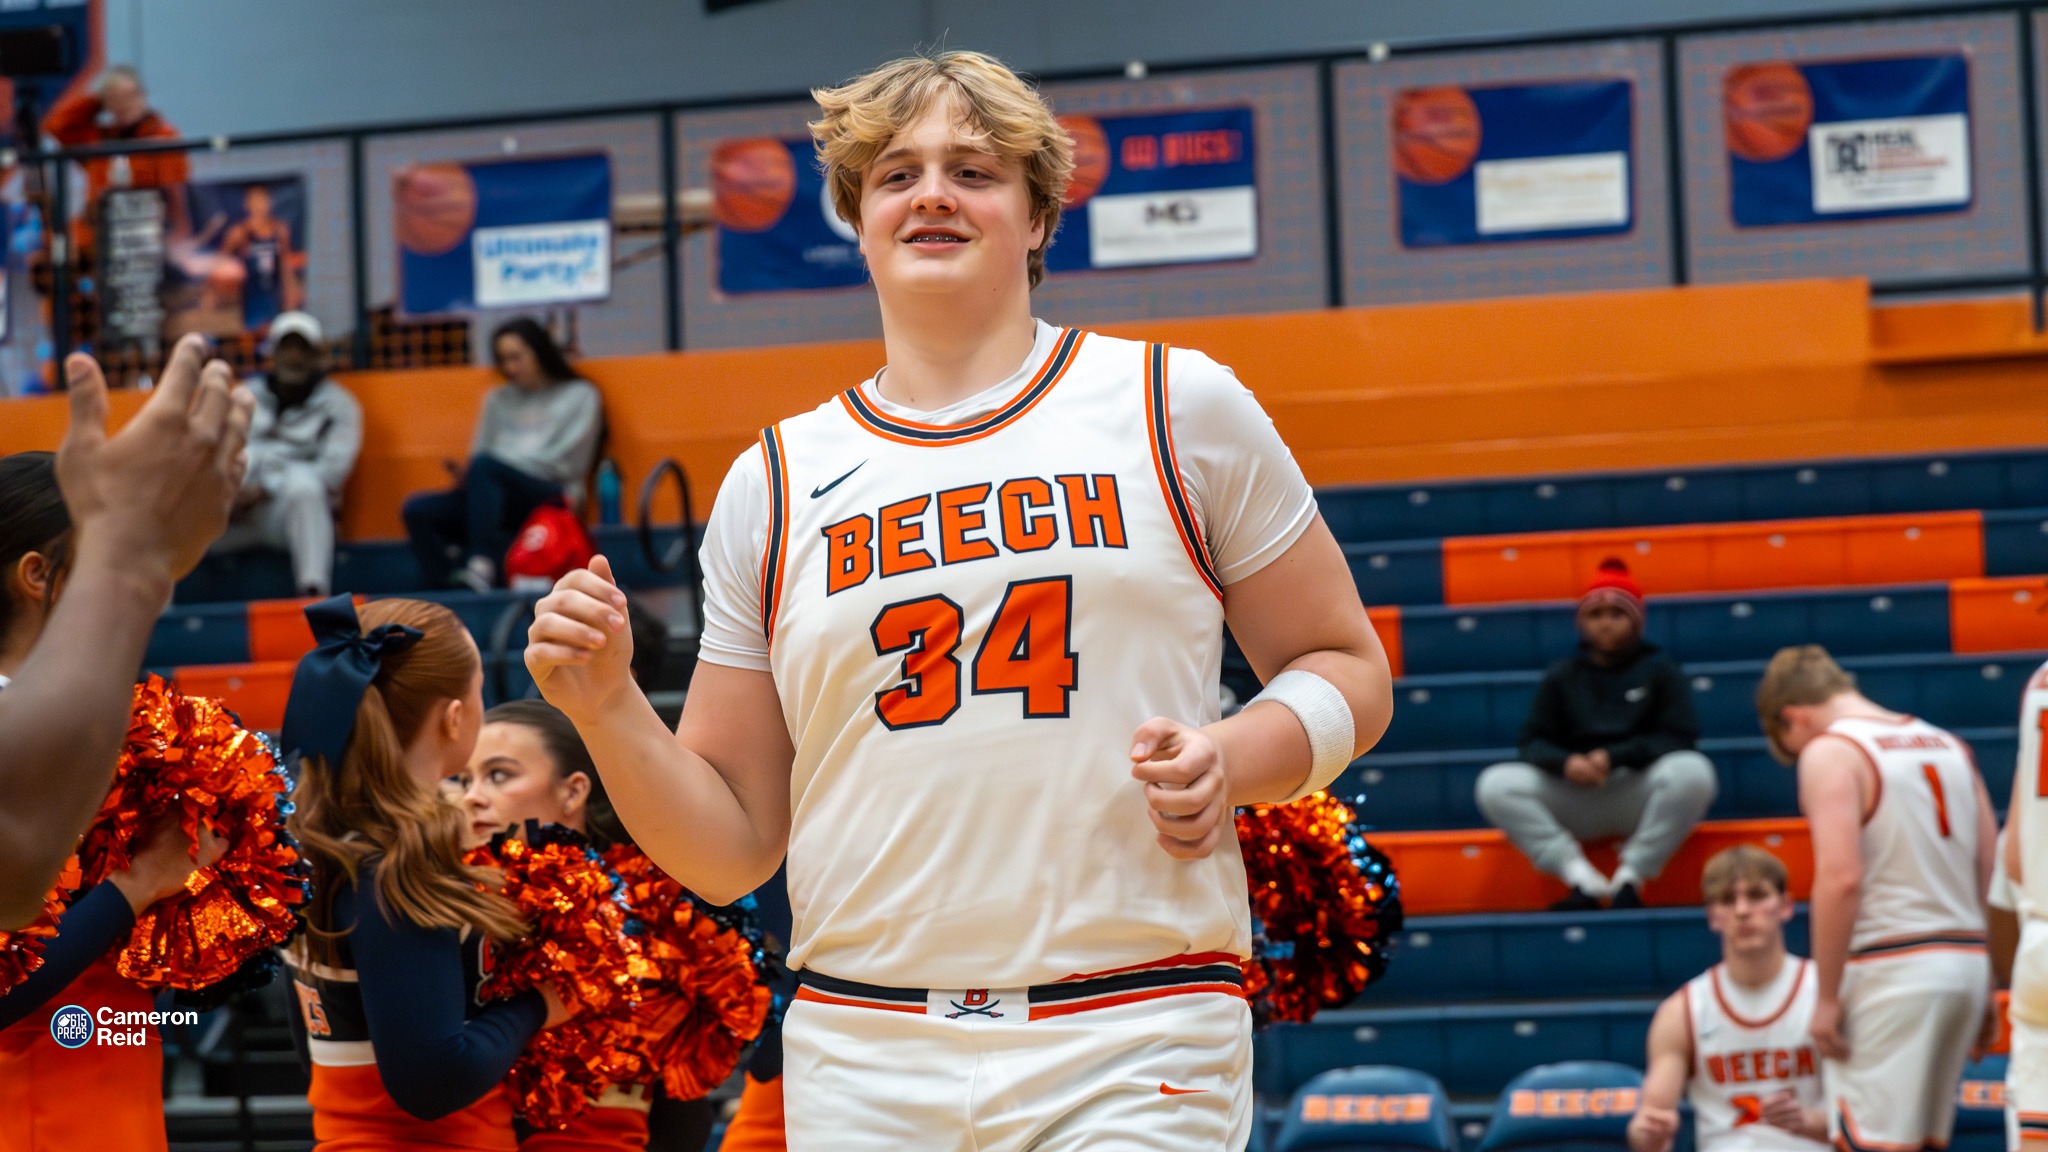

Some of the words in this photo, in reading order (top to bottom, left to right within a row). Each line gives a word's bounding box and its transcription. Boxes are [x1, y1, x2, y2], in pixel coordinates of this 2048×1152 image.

[821, 473, 1129, 598] BEECH
[869, 574, 1080, 731] 34
[1921, 763, 1951, 838] 1
[1706, 1046, 1815, 1085] BEECH
[1302, 1094, 1432, 1123] BEECH
